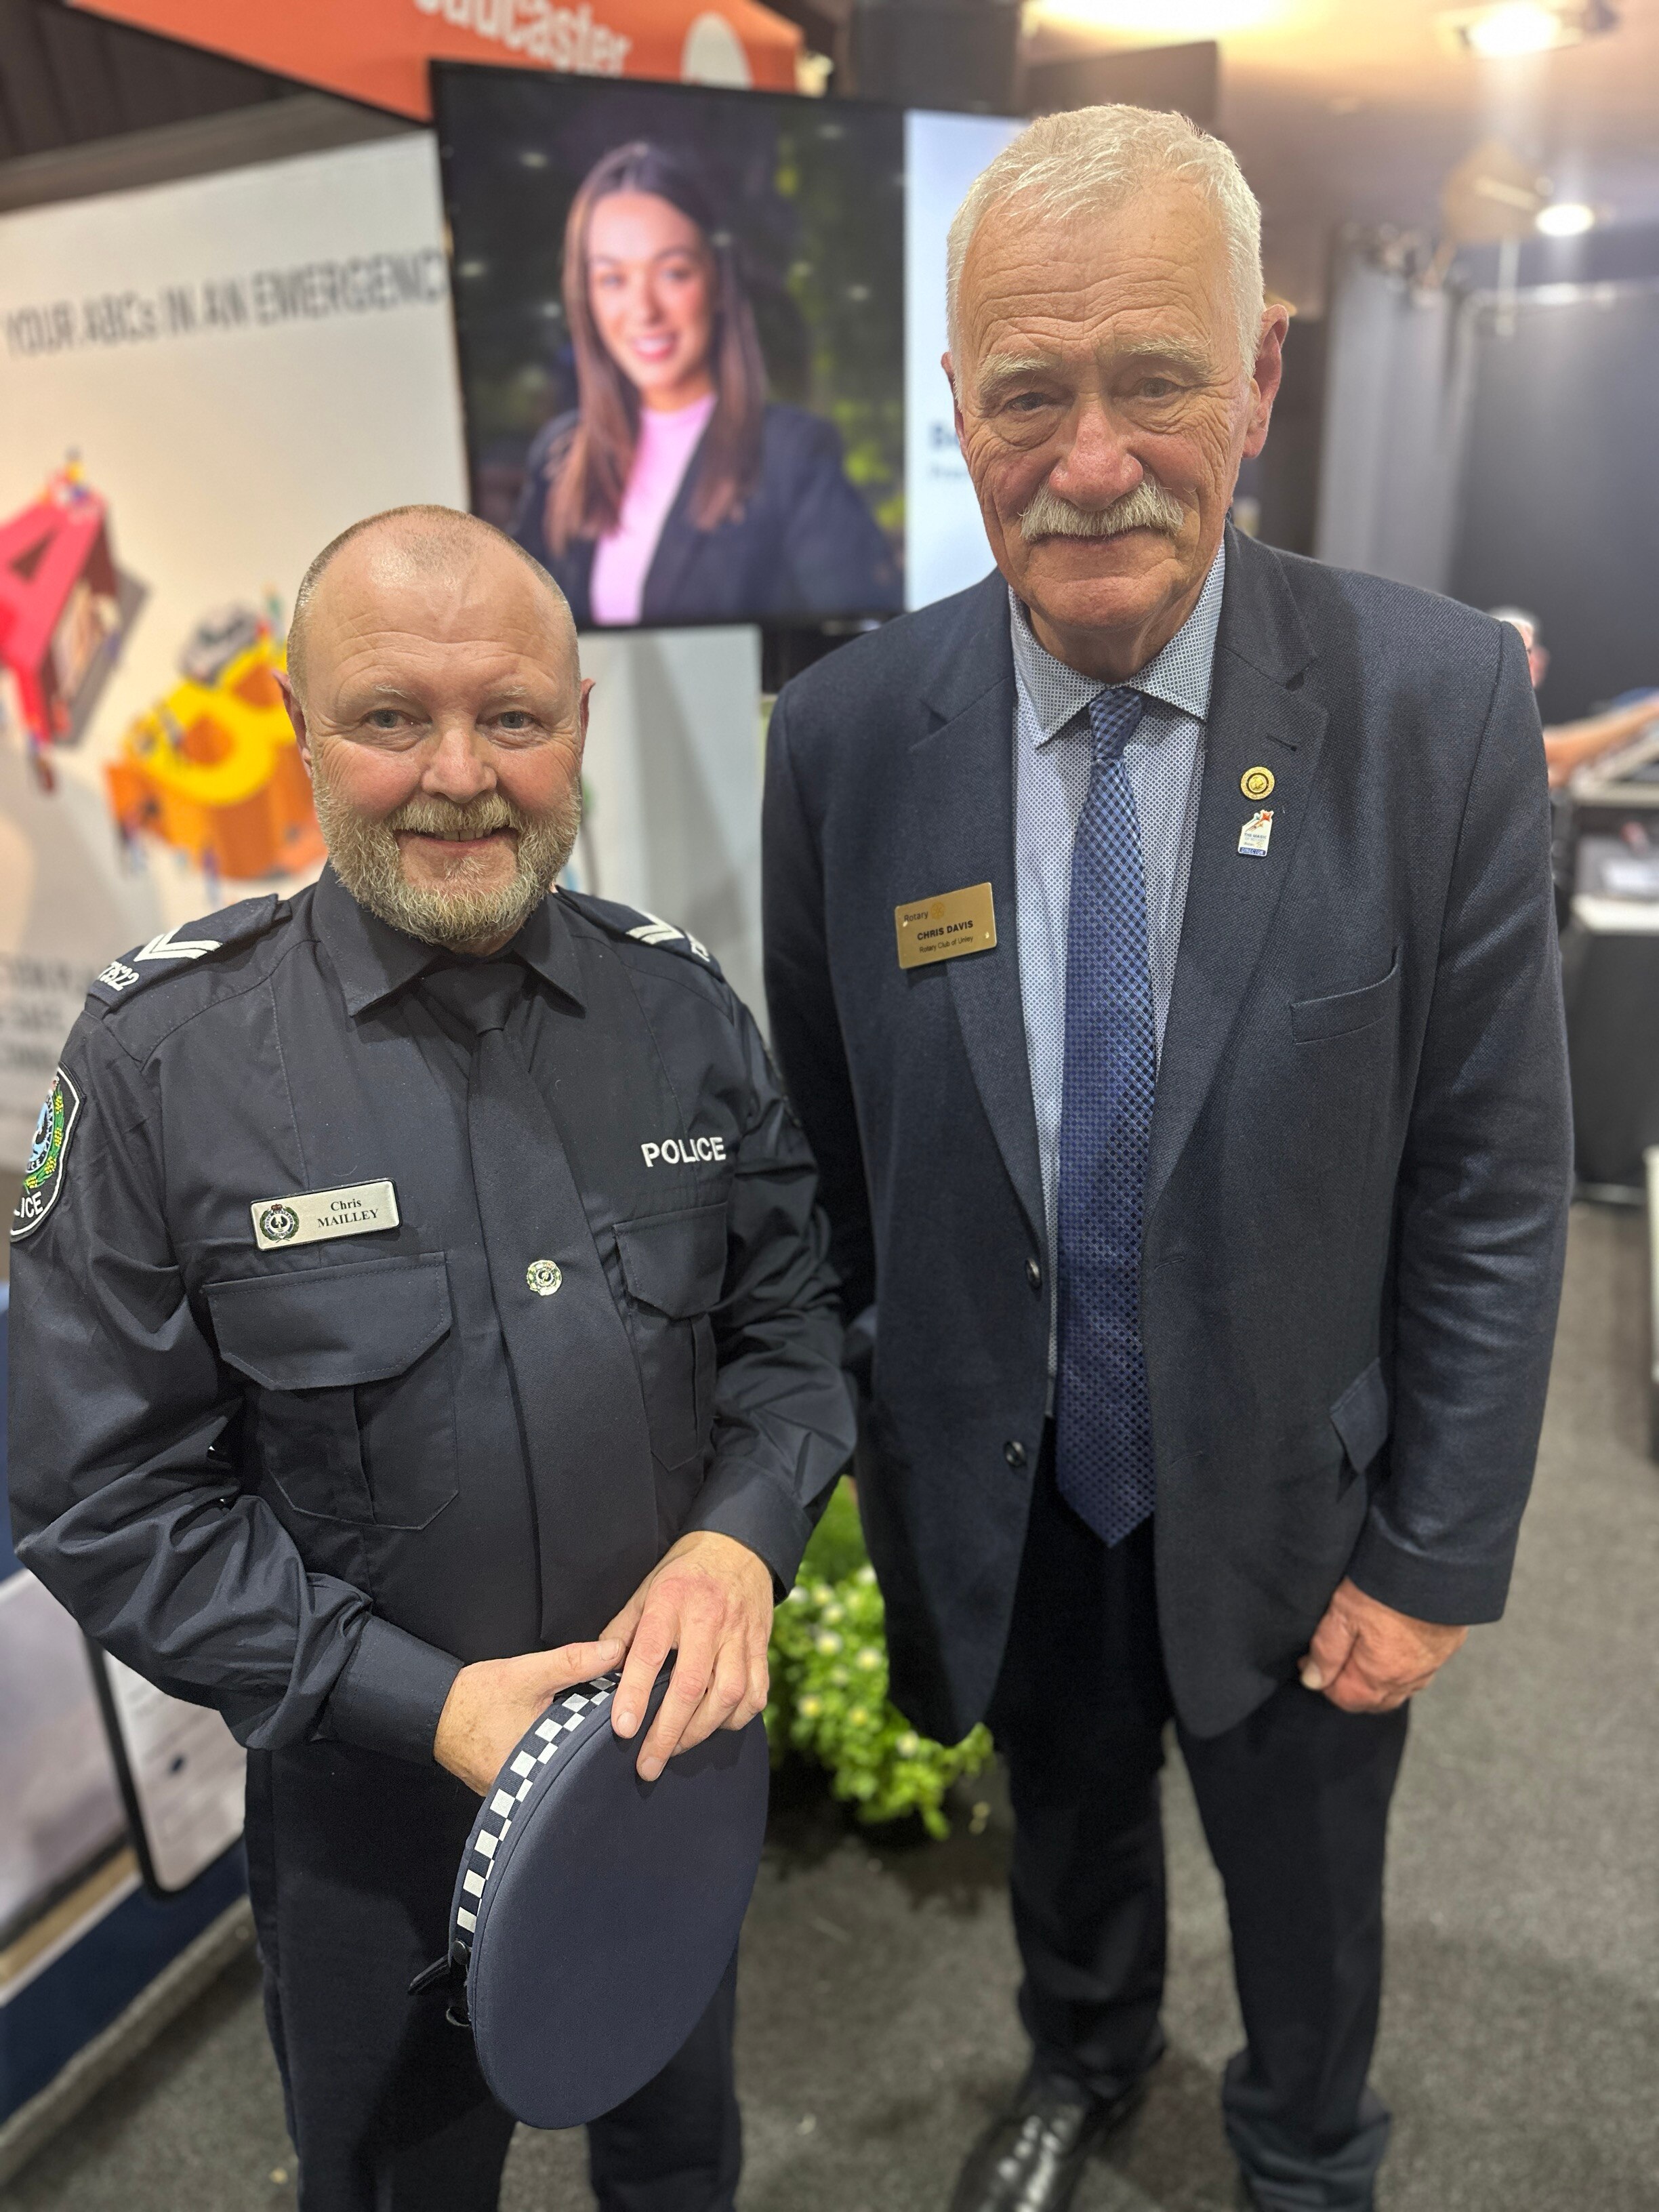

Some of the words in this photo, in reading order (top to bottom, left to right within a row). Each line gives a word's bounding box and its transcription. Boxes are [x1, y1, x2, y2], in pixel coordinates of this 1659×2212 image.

[904, 912, 928, 922] Rotary
[917, 927, 944, 941] CHRIS
[947, 920, 973, 934] DAVIS
[920, 944, 937, 954] Rotary
[958, 936, 973, 945] Unley
[641, 1137, 726, 1167] POLICE
[331, 1198, 362, 1211] Chris
[317, 1208, 380, 1227] MAILLEY
